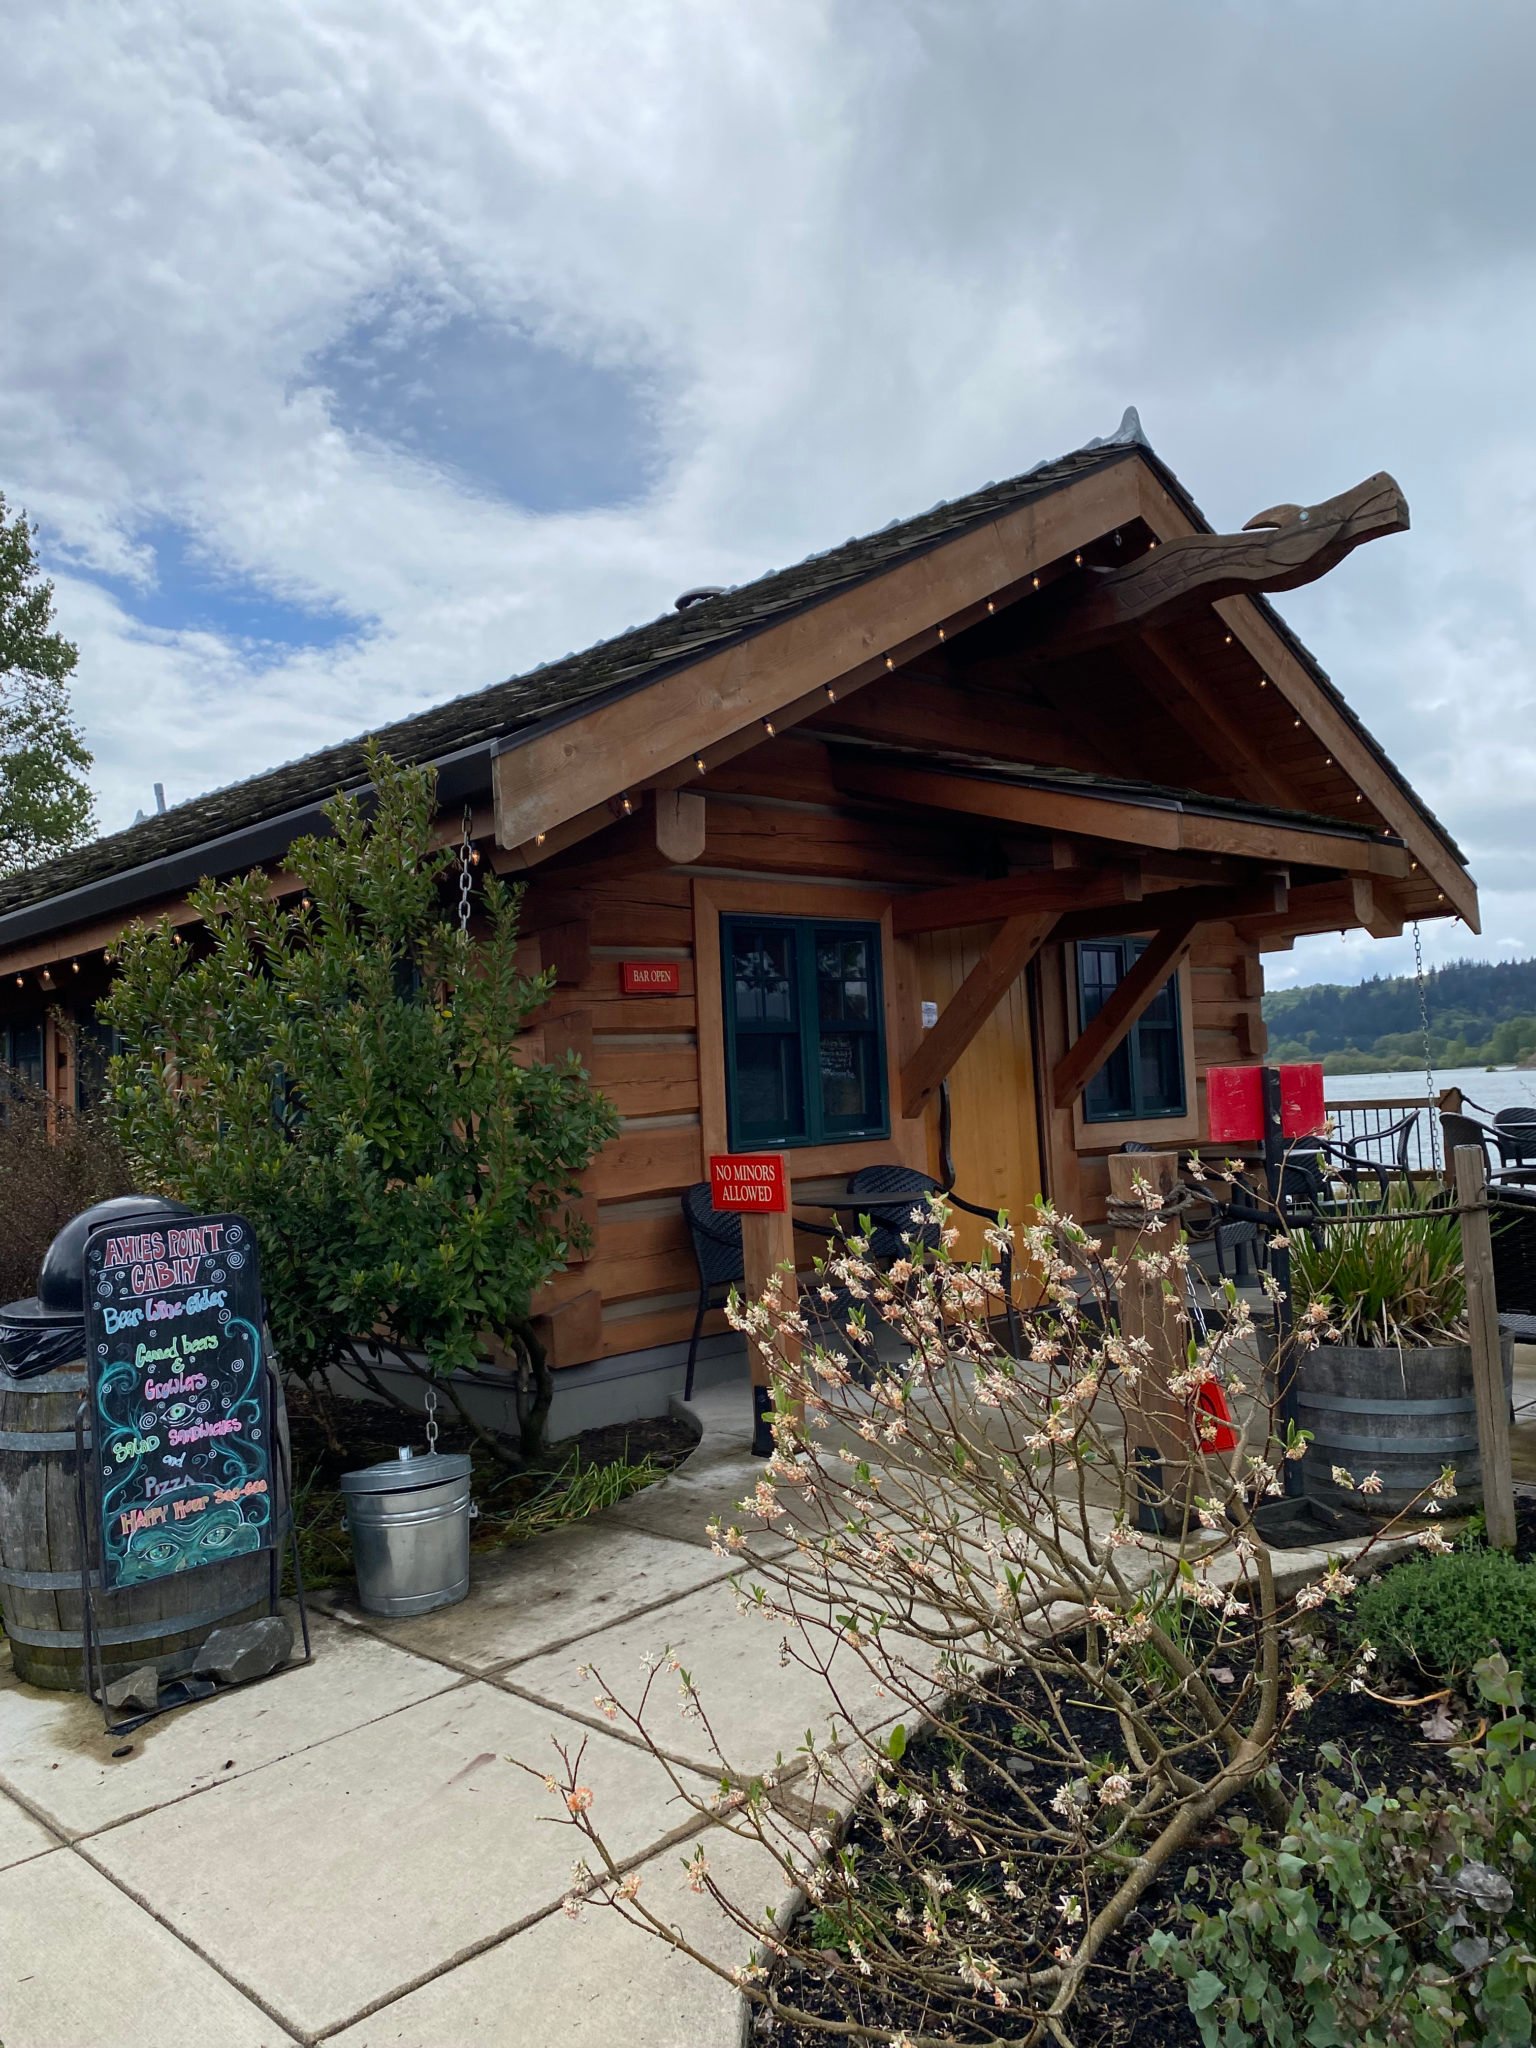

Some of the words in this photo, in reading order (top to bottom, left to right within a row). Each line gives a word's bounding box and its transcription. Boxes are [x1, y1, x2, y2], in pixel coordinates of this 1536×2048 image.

[633, 970, 650, 983] BAR
[650, 969, 671, 983] OPEN
[716, 1165, 732, 1181] NO
[733, 1164, 775, 1181] MINORS
[722, 1185, 772, 1203] ALLOWED
[168, 1224, 223, 1257] POINT
[131, 1256, 200, 1294] CABIN
[135, 1337, 179, 1368] Canned
[182, 1334, 218, 1355] beers
[171, 1358, 185, 1373] &
[144, 1372, 207, 1400] Growlers
[168, 1417, 242, 1446] SANDWICHES
[162, 1452, 187, 1468] and
